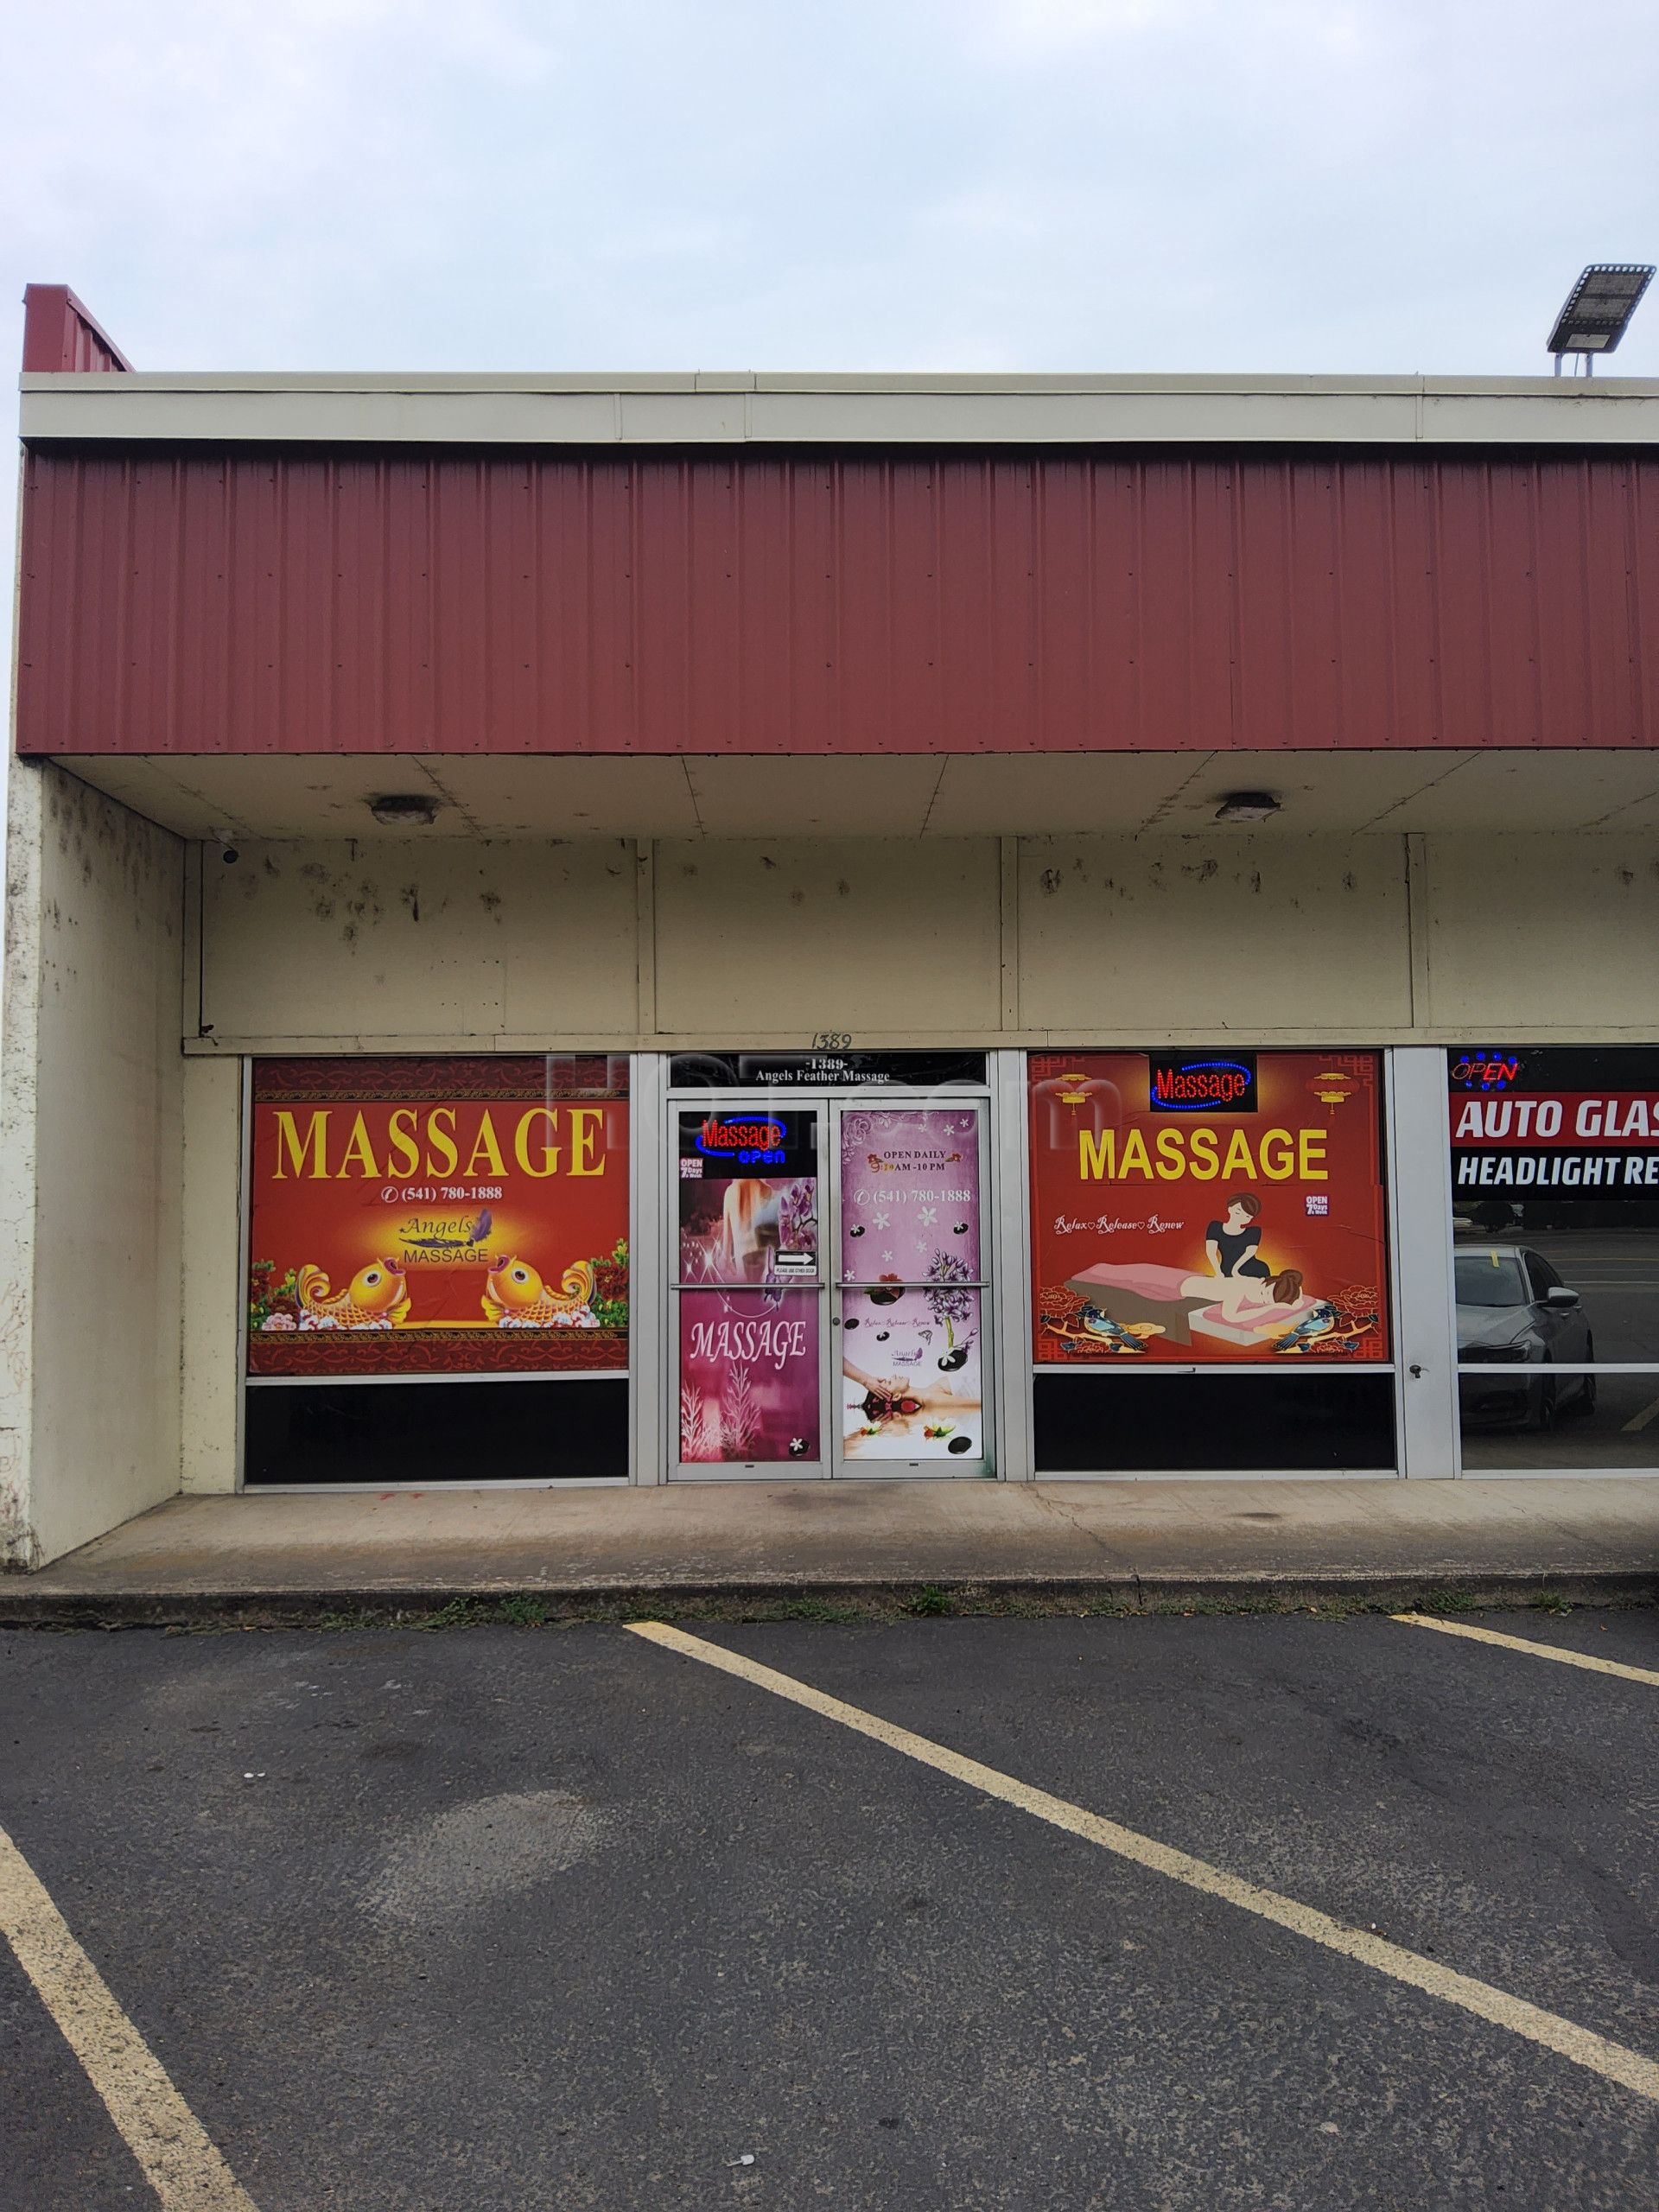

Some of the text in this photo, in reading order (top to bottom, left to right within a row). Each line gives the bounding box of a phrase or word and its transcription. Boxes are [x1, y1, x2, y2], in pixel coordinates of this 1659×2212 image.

[812, 1033, 852, 1050] 1389
[755, 1070, 890, 1084] Angels Feather Massage
[1452, 1061, 1518, 1080] OPEN
[1157, 1068, 1245, 1102] Massage
[1455, 1100, 1563, 1138] AUTO
[271, 1107, 607, 1179] MASSAGE
[702, 1119, 781, 1151] Massage
[680, 1158, 703, 1167] OPEN
[883, 1150, 947, 1159] OPEN DAILY
[1079, 1128, 1330, 1180] MASSAGE
[680, 1167, 688, 1178] 7
[1458, 1156, 1621, 1185] HEADLIGHT
[402, 1186, 502, 1202] (541) 780-1888
[874, 1189, 971, 1204] (541) 780-1888
[1306, 1204, 1313, 1215] 7
[399, 1215, 473, 1241] Angels
[1053, 1214, 1185, 1235] Relax Release Renew
[404, 1249, 488, 1262] MASSAGE
[690, 1319, 806, 1370] MASSAGE
